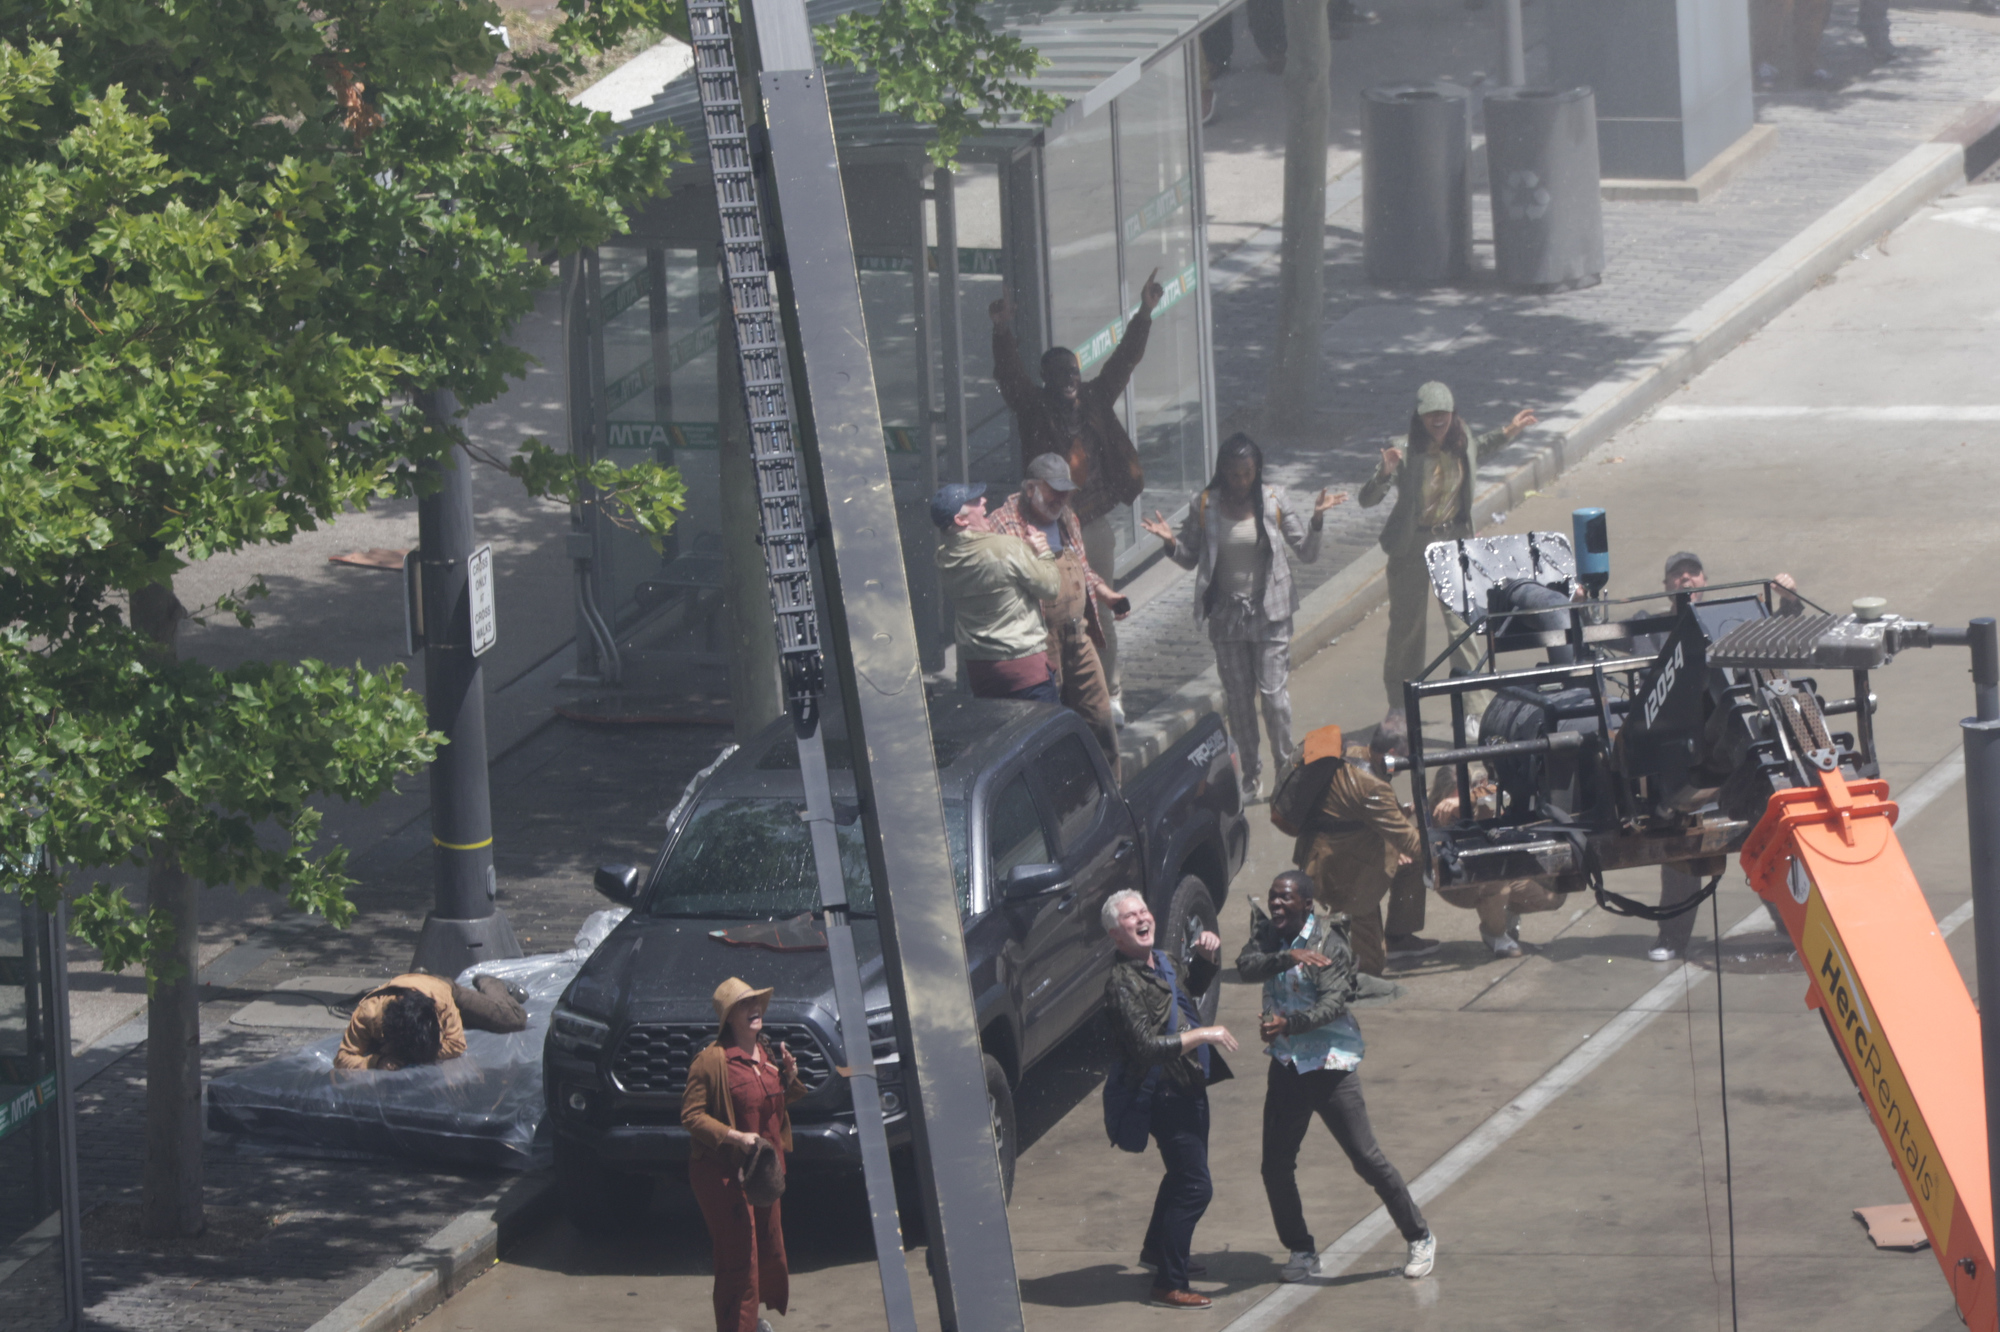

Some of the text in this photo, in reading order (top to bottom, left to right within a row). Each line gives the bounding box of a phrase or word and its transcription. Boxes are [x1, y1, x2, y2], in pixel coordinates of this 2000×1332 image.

[1156, 188, 1178, 218] MTA
[616, 279, 639, 311] MTA
[695, 323, 717, 353] MTA
[1091, 328, 1112, 361] MTA
[620, 371, 643, 399] MTA
[608, 424, 670, 447] MTA
[472, 556, 489, 577] CROSS
[475, 575, 488, 591] ONLY
[479, 592, 485, 603] AT
[474, 604, 492, 625] CROSS
[475, 621, 492, 641] WALKS
[1187, 742, 1210, 767] TRD
[1819, 947, 1935, 1202] HercRentals
[11, 1088, 37, 1124] MTA
